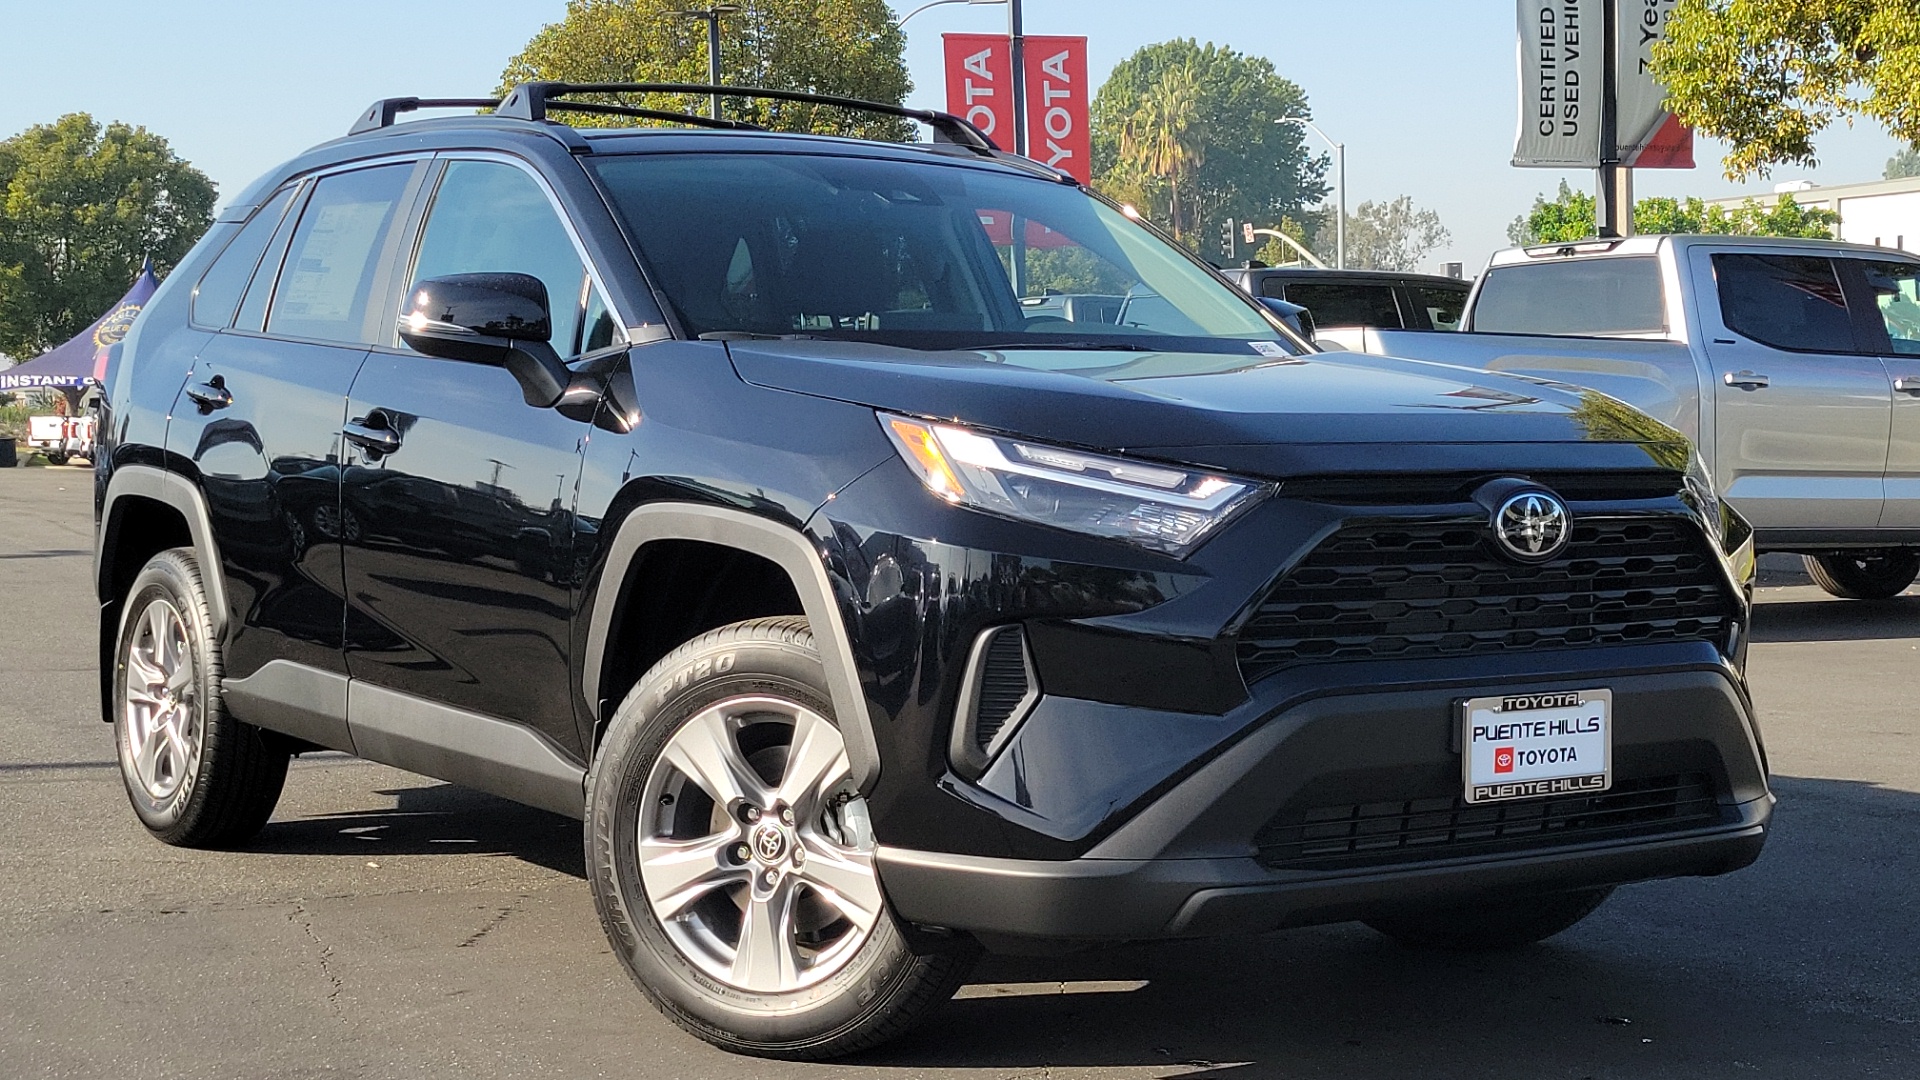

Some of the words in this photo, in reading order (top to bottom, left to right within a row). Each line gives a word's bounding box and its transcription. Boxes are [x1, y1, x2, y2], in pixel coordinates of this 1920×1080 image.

[1564, 0, 1580, 62] VEHI
[964, 48, 996, 137] OTA
[1539, 7, 1556, 137] CERTIFIED
[1043, 50, 1073, 179] YOTA
[1562, 70, 1579, 137] USED
[0, 375, 78, 390] INSTANT
[655, 652, 736, 709] PT20
[1504, 693, 1578, 711] TOYOTA
[1473, 720, 1546, 743] PUENTE
[1549, 716, 1600, 736] HILLS
[1518, 746, 1577, 767] TOYOTA
[1475, 781, 1549, 800] PUENTE
[1551, 775, 1603, 792] HILLS
